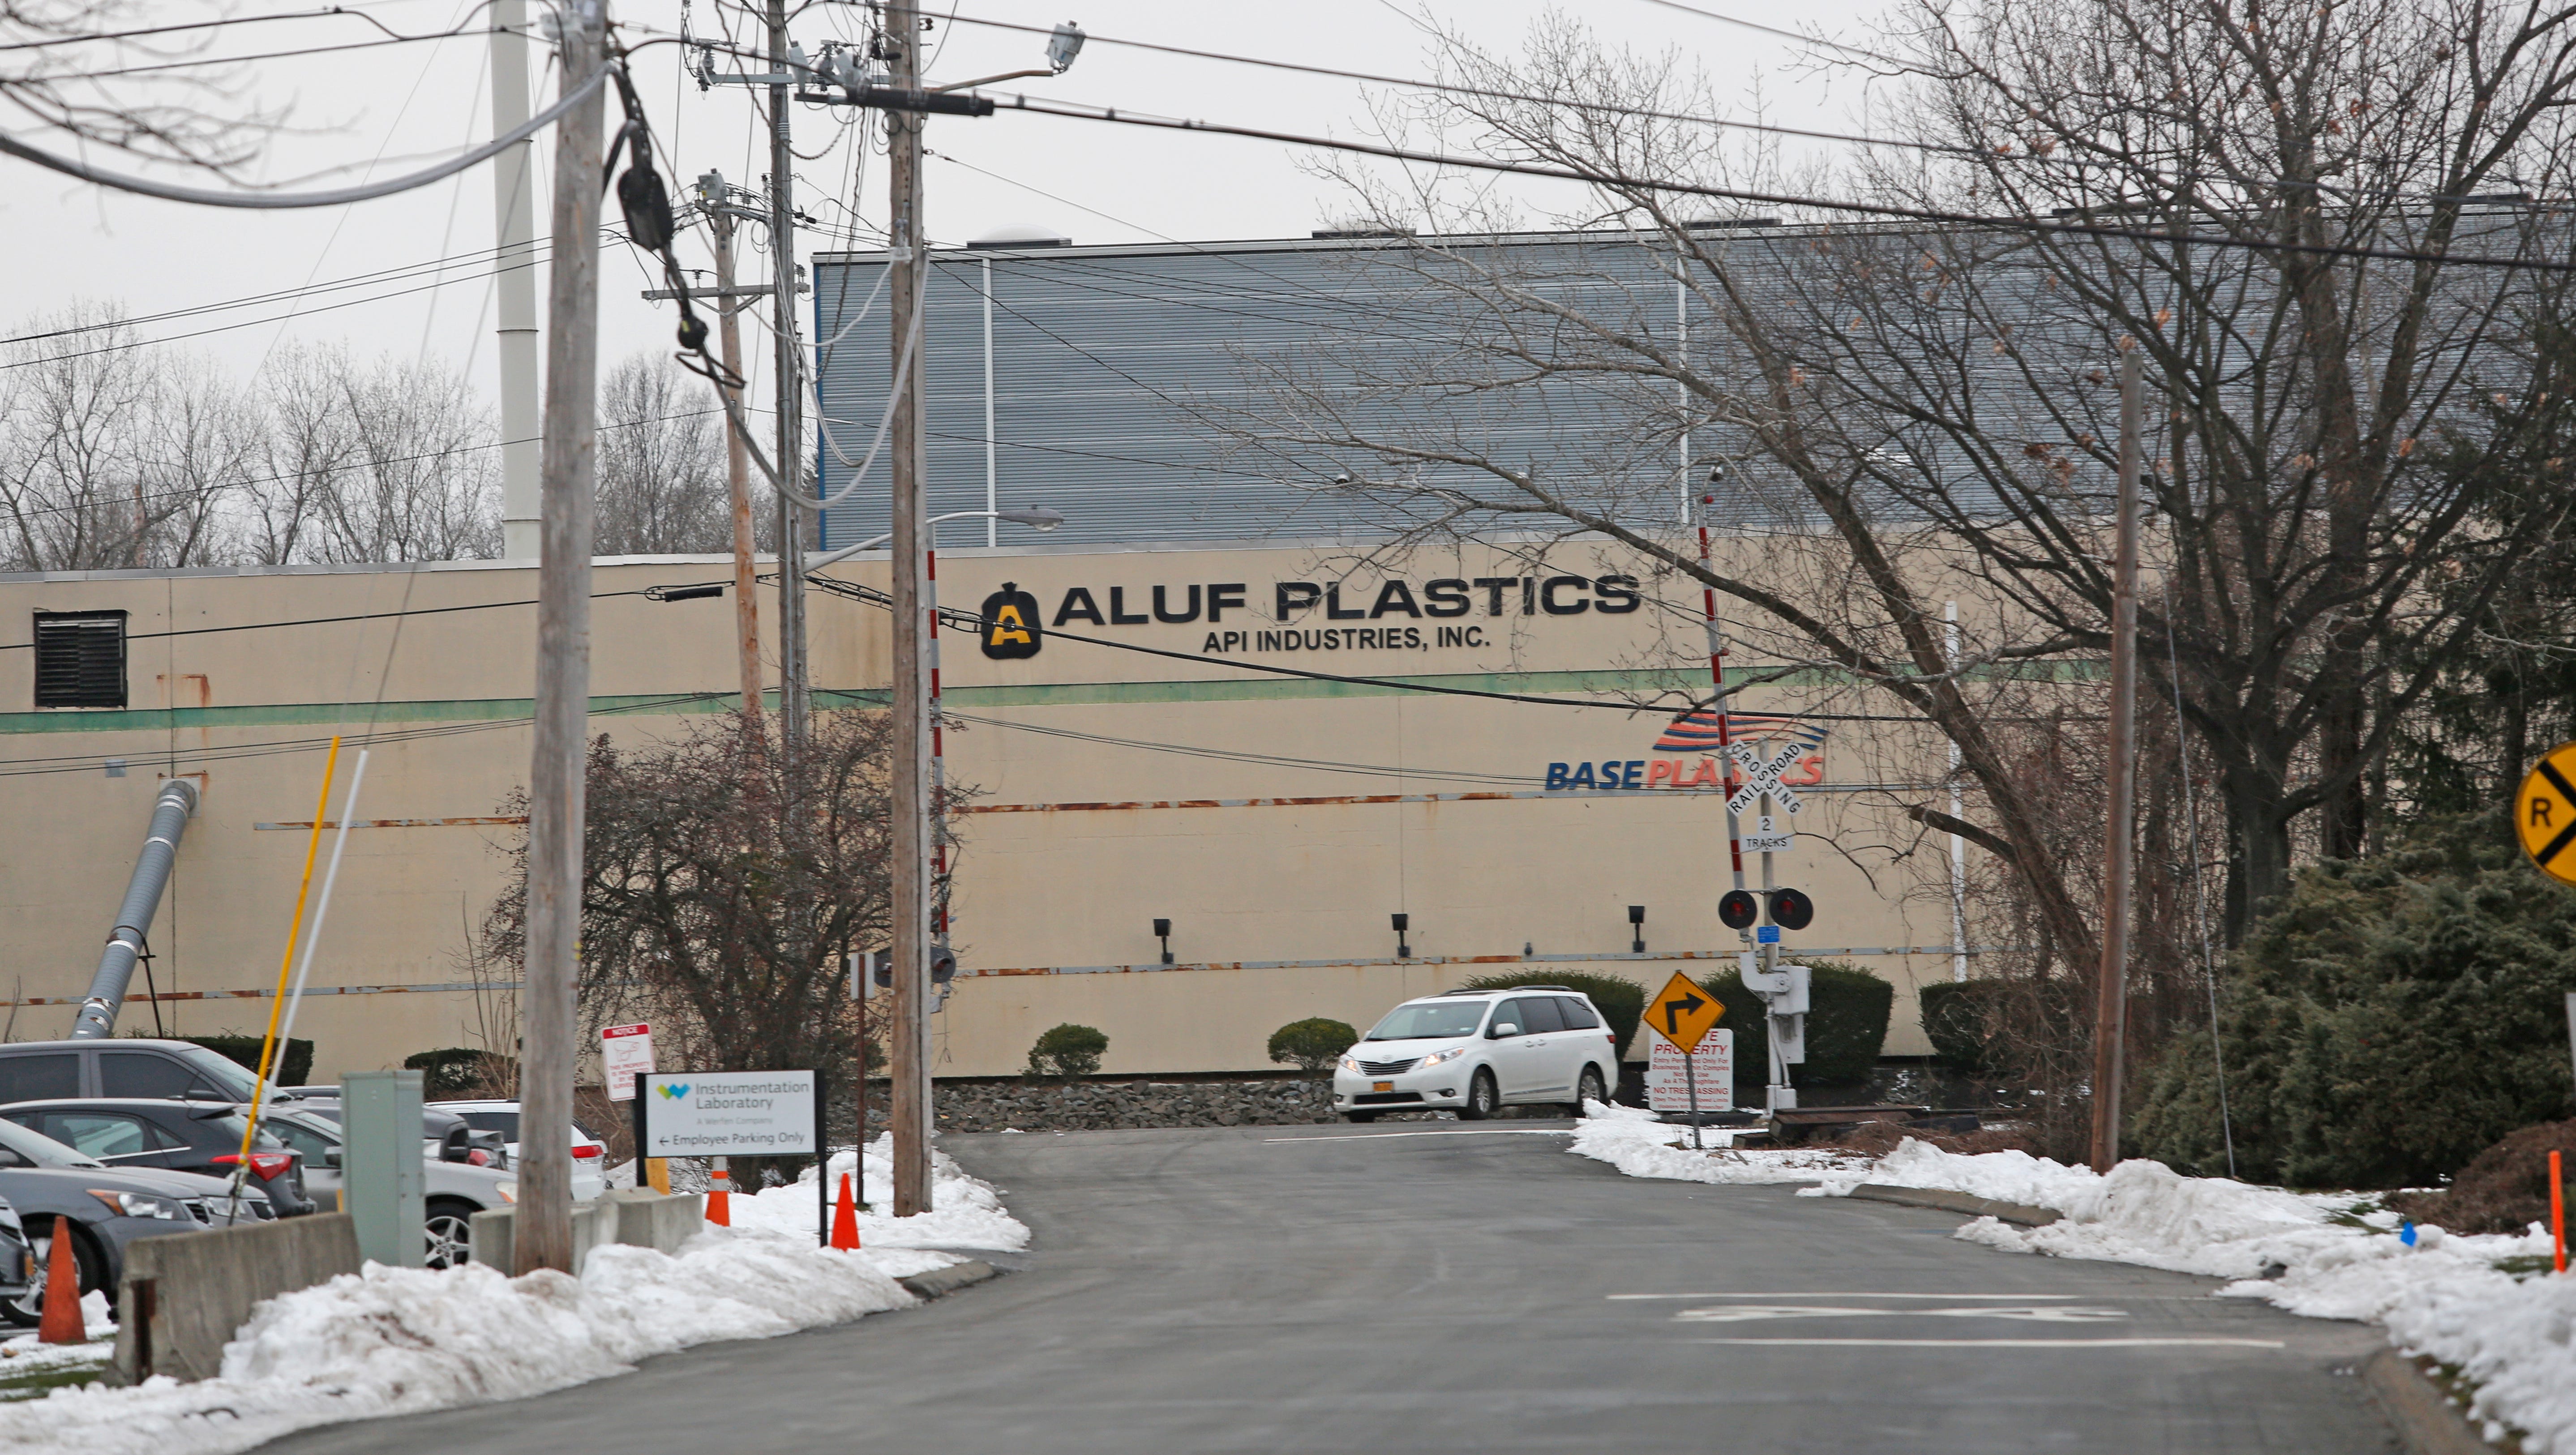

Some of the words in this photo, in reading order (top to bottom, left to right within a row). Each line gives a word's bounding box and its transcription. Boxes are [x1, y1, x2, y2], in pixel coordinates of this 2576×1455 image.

[1052, 583, 1246, 626] ALUF
[1276, 574, 1641, 621] PLASTICS
[1203, 630, 1247, 653] API
[1257, 627, 1428, 652] INDUSTRIES,
[1437, 626, 1491, 648] INC.
[2531, 797, 2552, 827] R
[1762, 817, 1771, 831] 2
[1746, 838, 1787, 847] TRACKS
[1654, 1044, 1728, 1055] PROERTY
[695, 1082, 810, 1095] Instrumentation
[696, 1097, 774, 1110] Laboratory
[673, 1134, 729, 1147] Employee
[732, 1132, 775, 1146] Parking
[779, 1132, 804, 1145] Only
